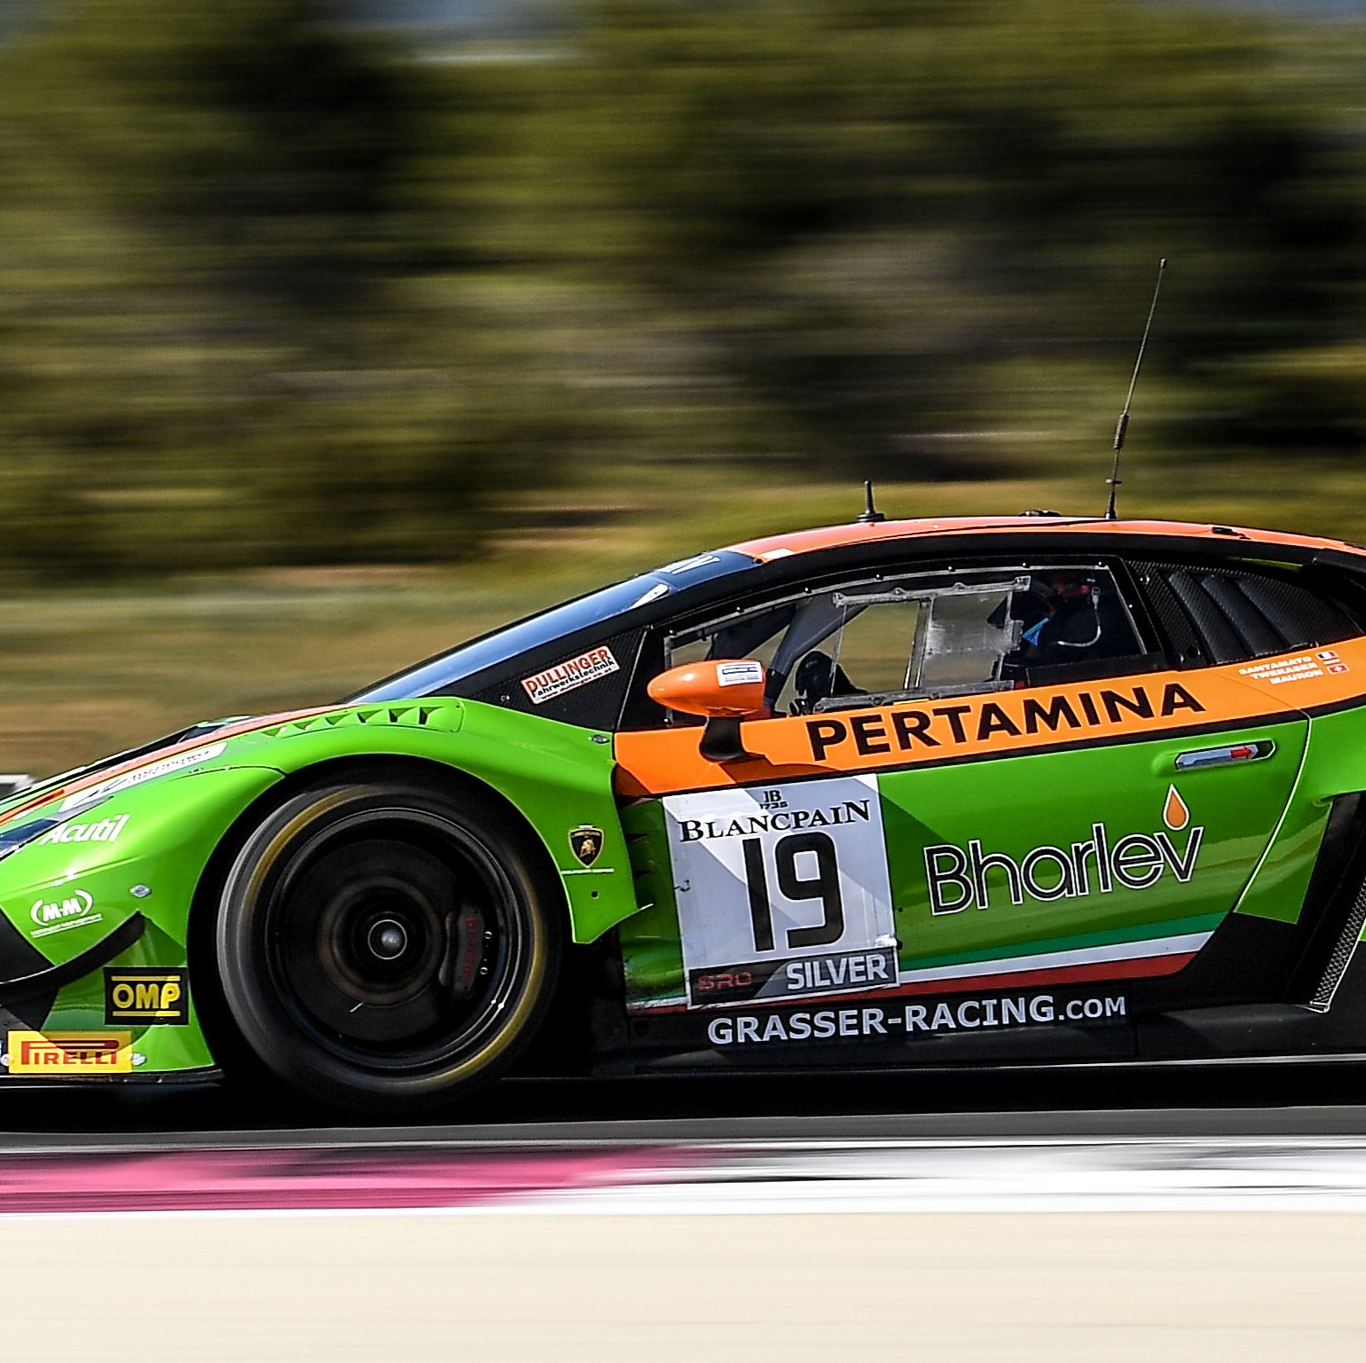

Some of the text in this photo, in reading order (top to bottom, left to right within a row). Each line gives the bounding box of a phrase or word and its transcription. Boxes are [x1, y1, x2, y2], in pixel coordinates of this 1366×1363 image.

[524, 649, 608, 693] DULLINGER
[806, 683, 1206, 762] PERTAMINA
[38, 813, 131, 846] Acutil
[678, 799, 871, 842] BLANCPAIN
[924, 823, 1204, 916] Bharlev
[742, 830, 846, 953] 19
[786, 953, 889, 991] SILVER
[112, 982, 181, 1009] OMP
[21, 1039, 120, 1065] PIRELLI
